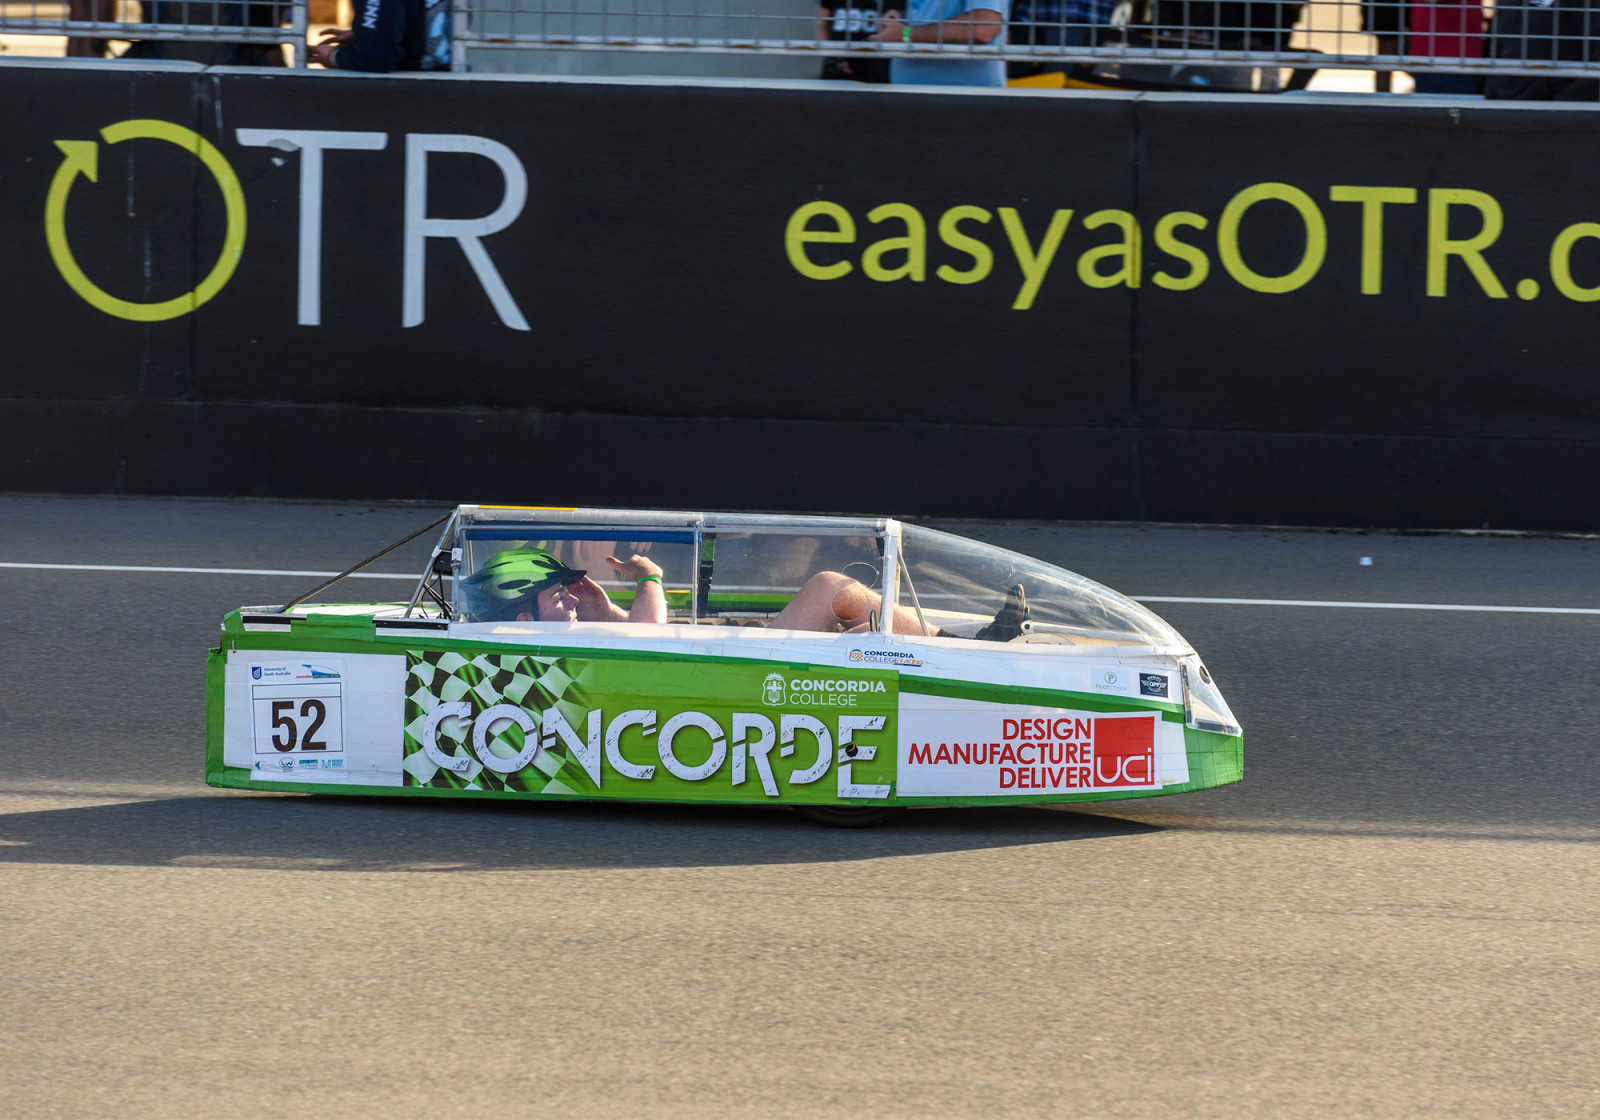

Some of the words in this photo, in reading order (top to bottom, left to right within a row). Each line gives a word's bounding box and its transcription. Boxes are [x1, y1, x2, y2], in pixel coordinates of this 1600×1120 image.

[864, 650, 914, 659] CONCORDIA
[790, 679, 886, 693] CONCORDIA
[790, 693, 857, 706] COLLEGE
[271, 699, 327, 752] 52
[1002, 718, 1092, 741] DESIGN
[422, 701, 891, 799] CONCORDE
[908, 742, 1092, 765] MANUFACTURE
[999, 767, 1092, 789] DELIVER
